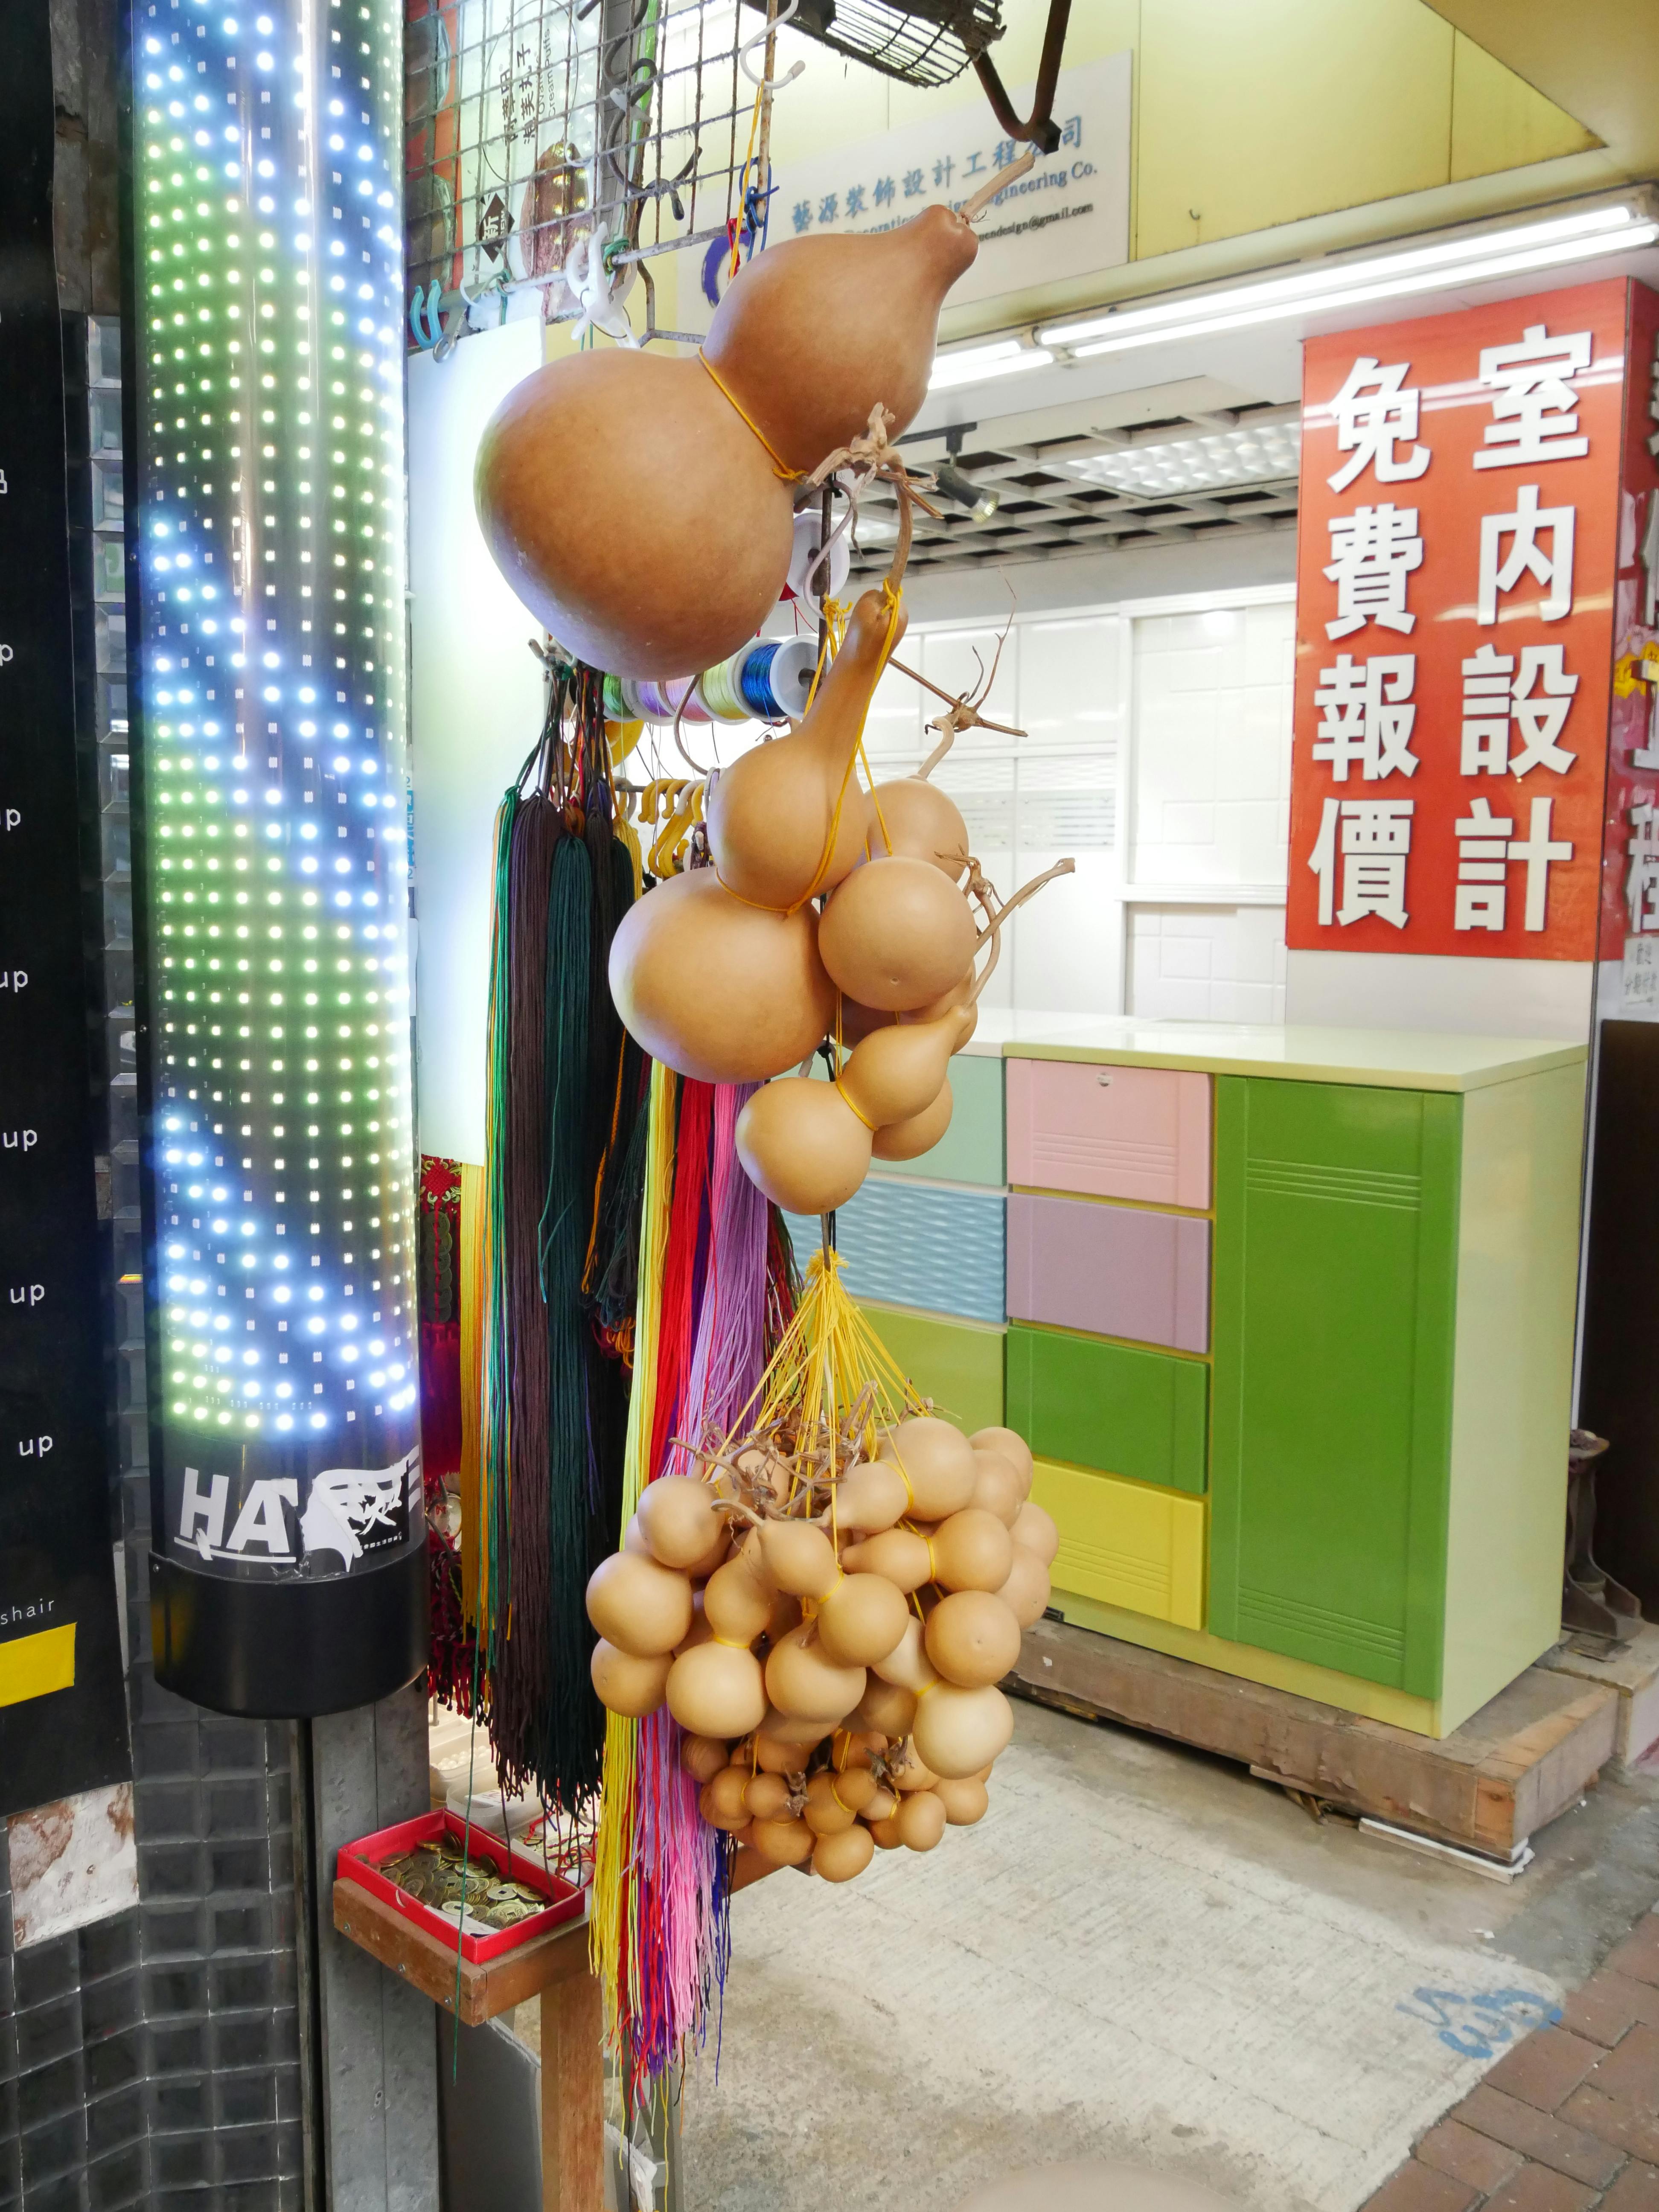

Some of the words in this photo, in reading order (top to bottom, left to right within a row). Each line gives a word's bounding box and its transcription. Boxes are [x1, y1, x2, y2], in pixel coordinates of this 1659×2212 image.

[1071, 161, 1097, 179] Co.
[1308, 357, 1432, 930] 免費報價
[3, 1129, 38, 1151] up
[11, 1284, 44, 1306] up
[19, 1435, 52, 1458] up
